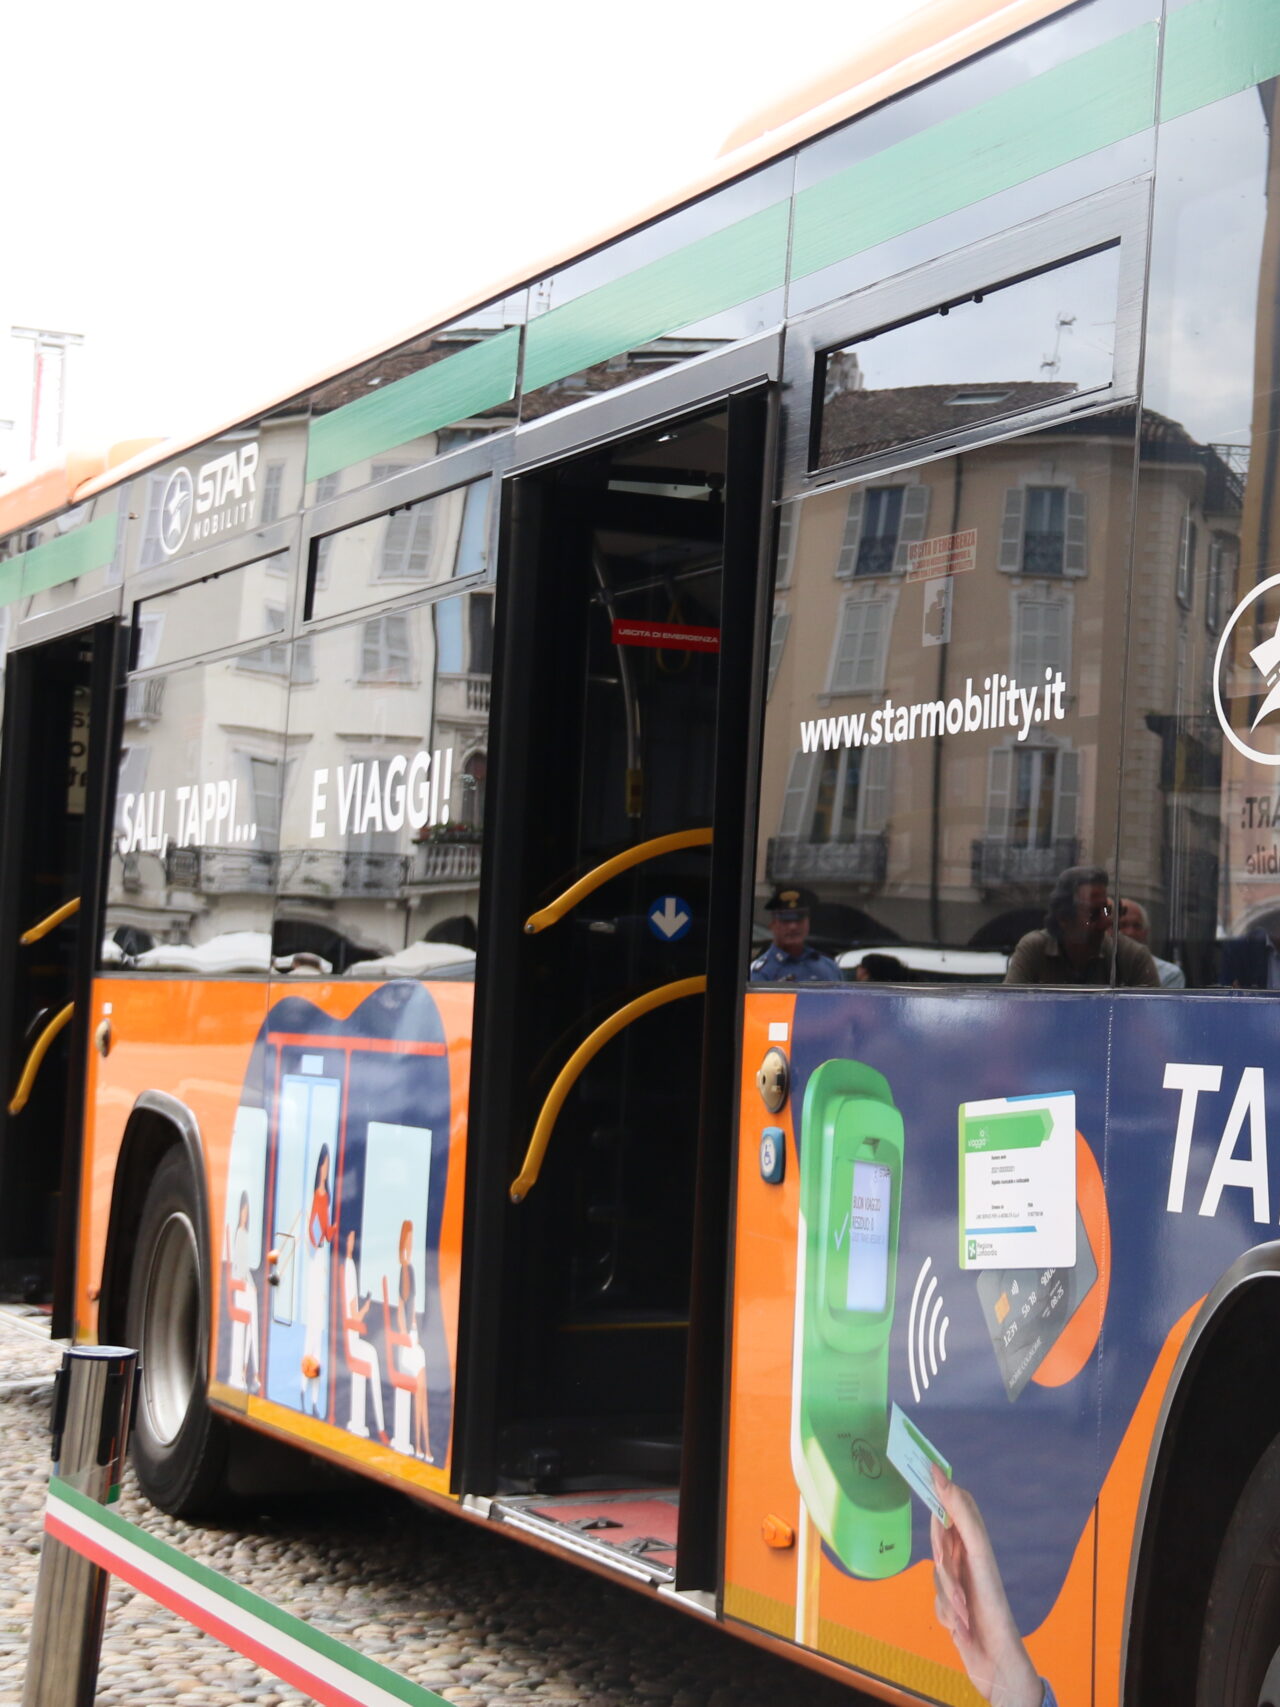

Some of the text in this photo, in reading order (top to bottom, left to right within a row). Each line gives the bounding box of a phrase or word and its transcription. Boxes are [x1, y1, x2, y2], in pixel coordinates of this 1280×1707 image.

[196, 442, 259, 514] STAR
[193, 499, 256, 541] MOBILITY
[618, 628, 651, 637] USCITA
[663, 632, 718, 643] EMERGENZA
[800, 666, 1066, 753] www.starmobility.it
[120, 779, 257, 859] SALI, TAPPI...
[309, 748, 453, 839] E VIAGGI!
[1003, 1321, 1018, 1347] 1234
